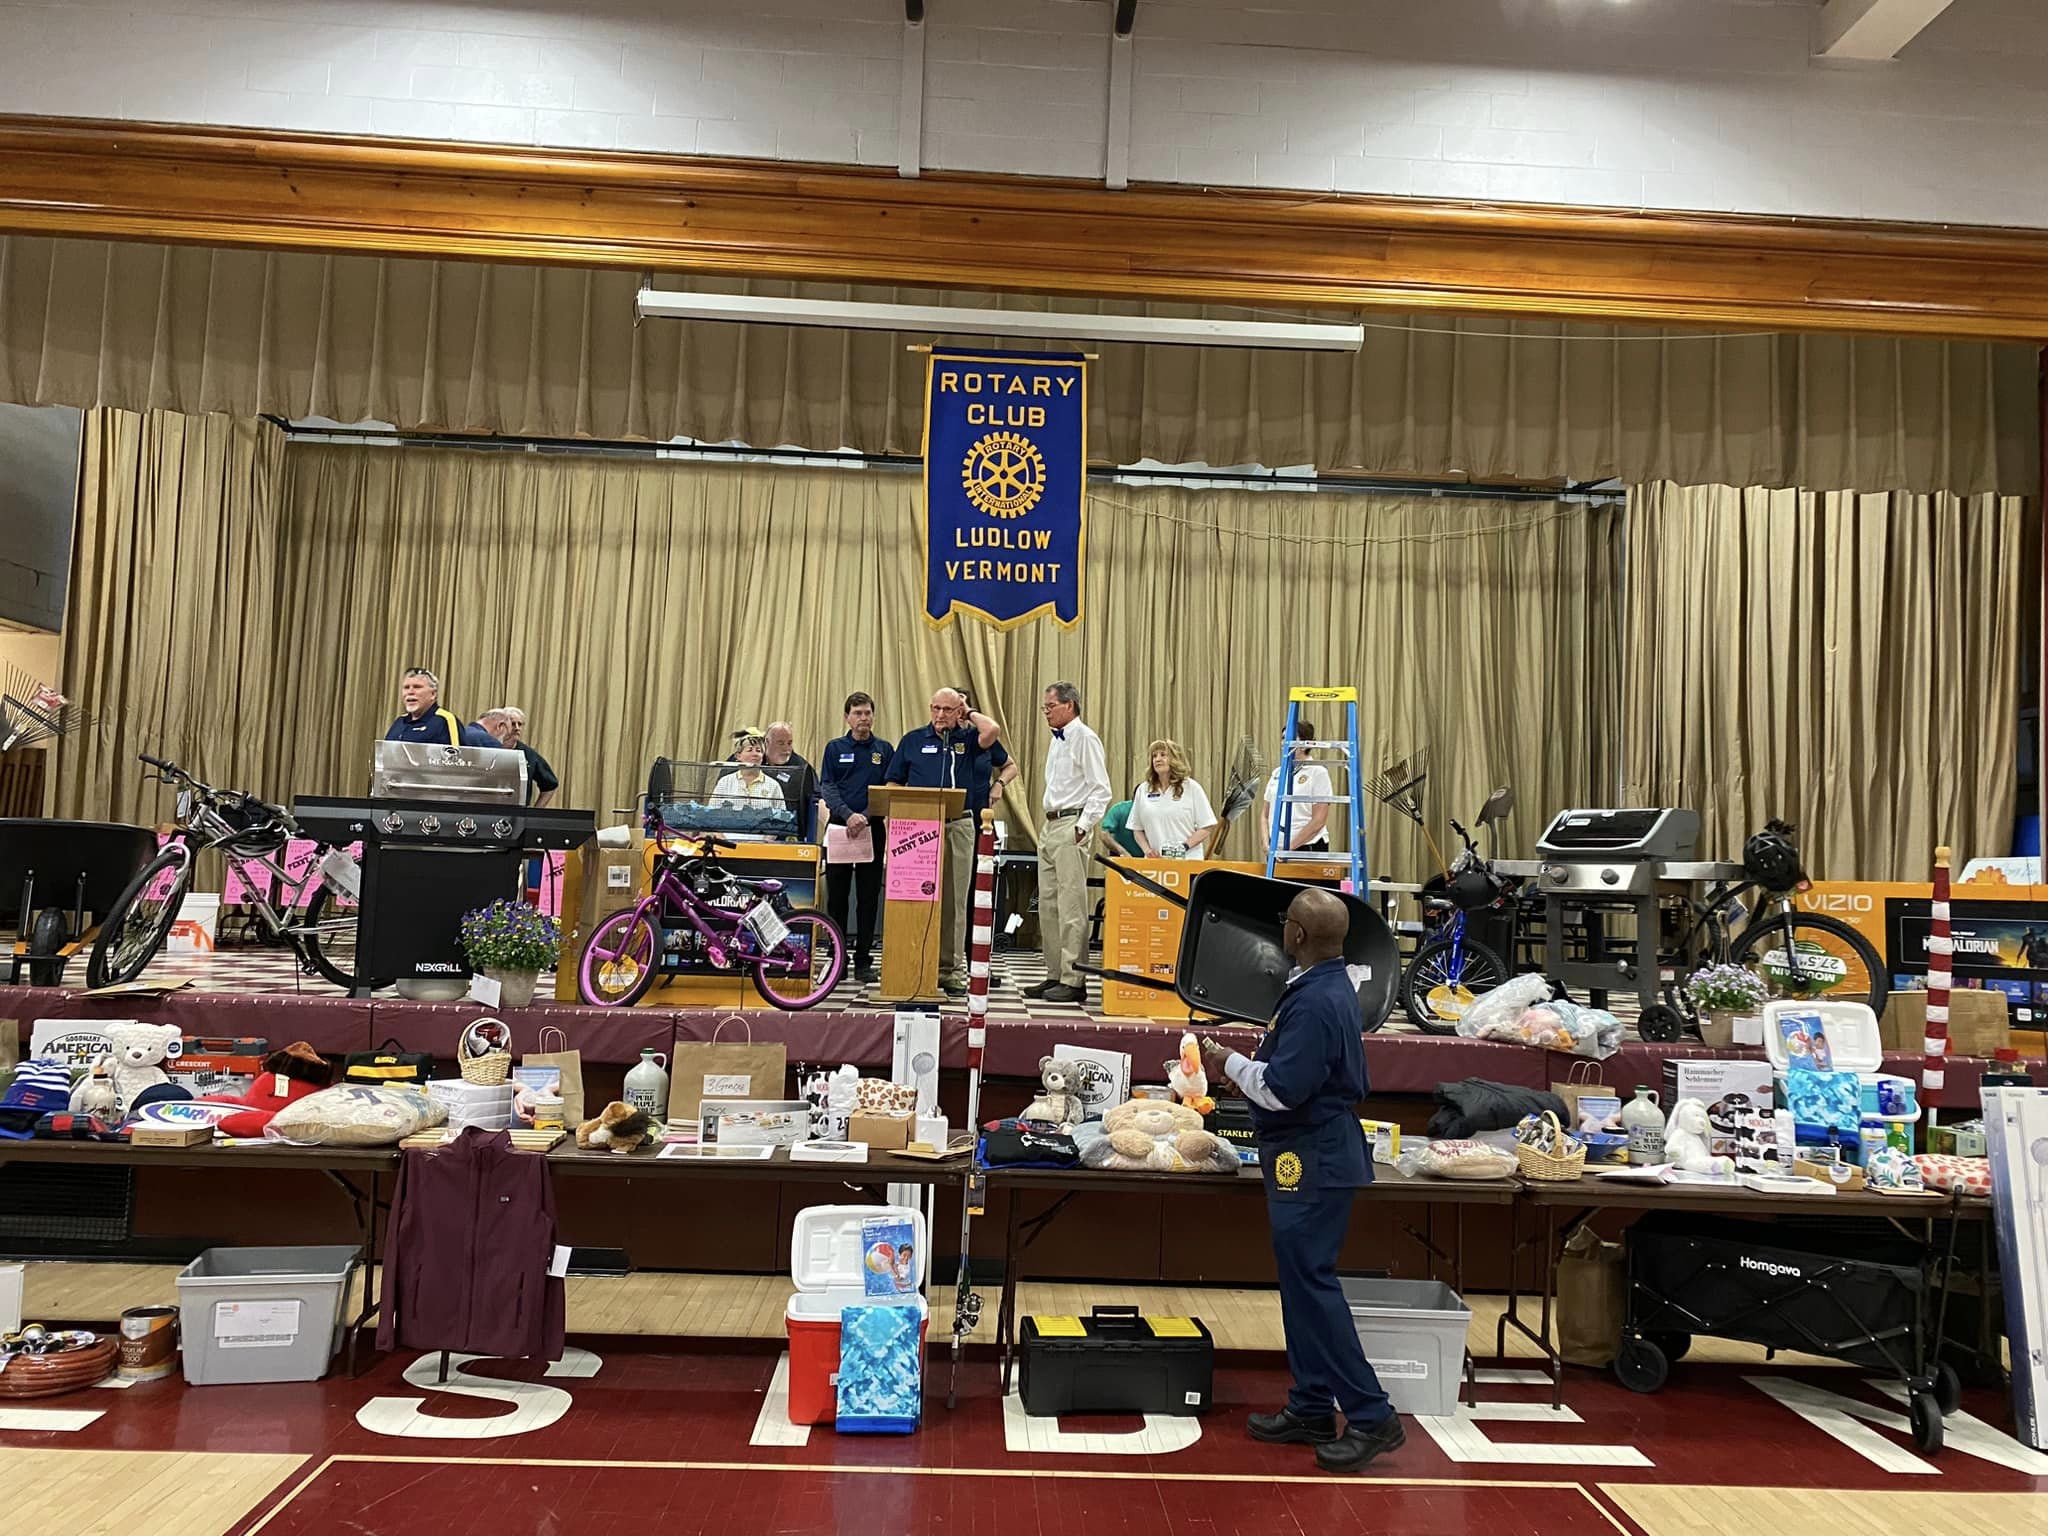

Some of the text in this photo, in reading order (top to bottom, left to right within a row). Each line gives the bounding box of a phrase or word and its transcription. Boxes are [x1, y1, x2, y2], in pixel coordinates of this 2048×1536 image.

[940, 371, 1075, 396] ROTARY
[967, 403, 1046, 427] CLUB
[983, 440, 1028, 457] ROTARY
[973, 482, 1034, 509] INTERNATIONAL
[955, 527, 1052, 550] LUDLOW
[945, 560, 1061, 583] VERMONT
[891, 830, 939, 857] PENNY SALE
[1803, 894, 1873, 912] VIZIO
[1922, 937, 1999, 954] MALORIAN
[161, 1103, 210, 1121] MARY
[1217, 1129, 1255, 1139] STANLEY
[1740, 1256, 1801, 1276] Homgava
